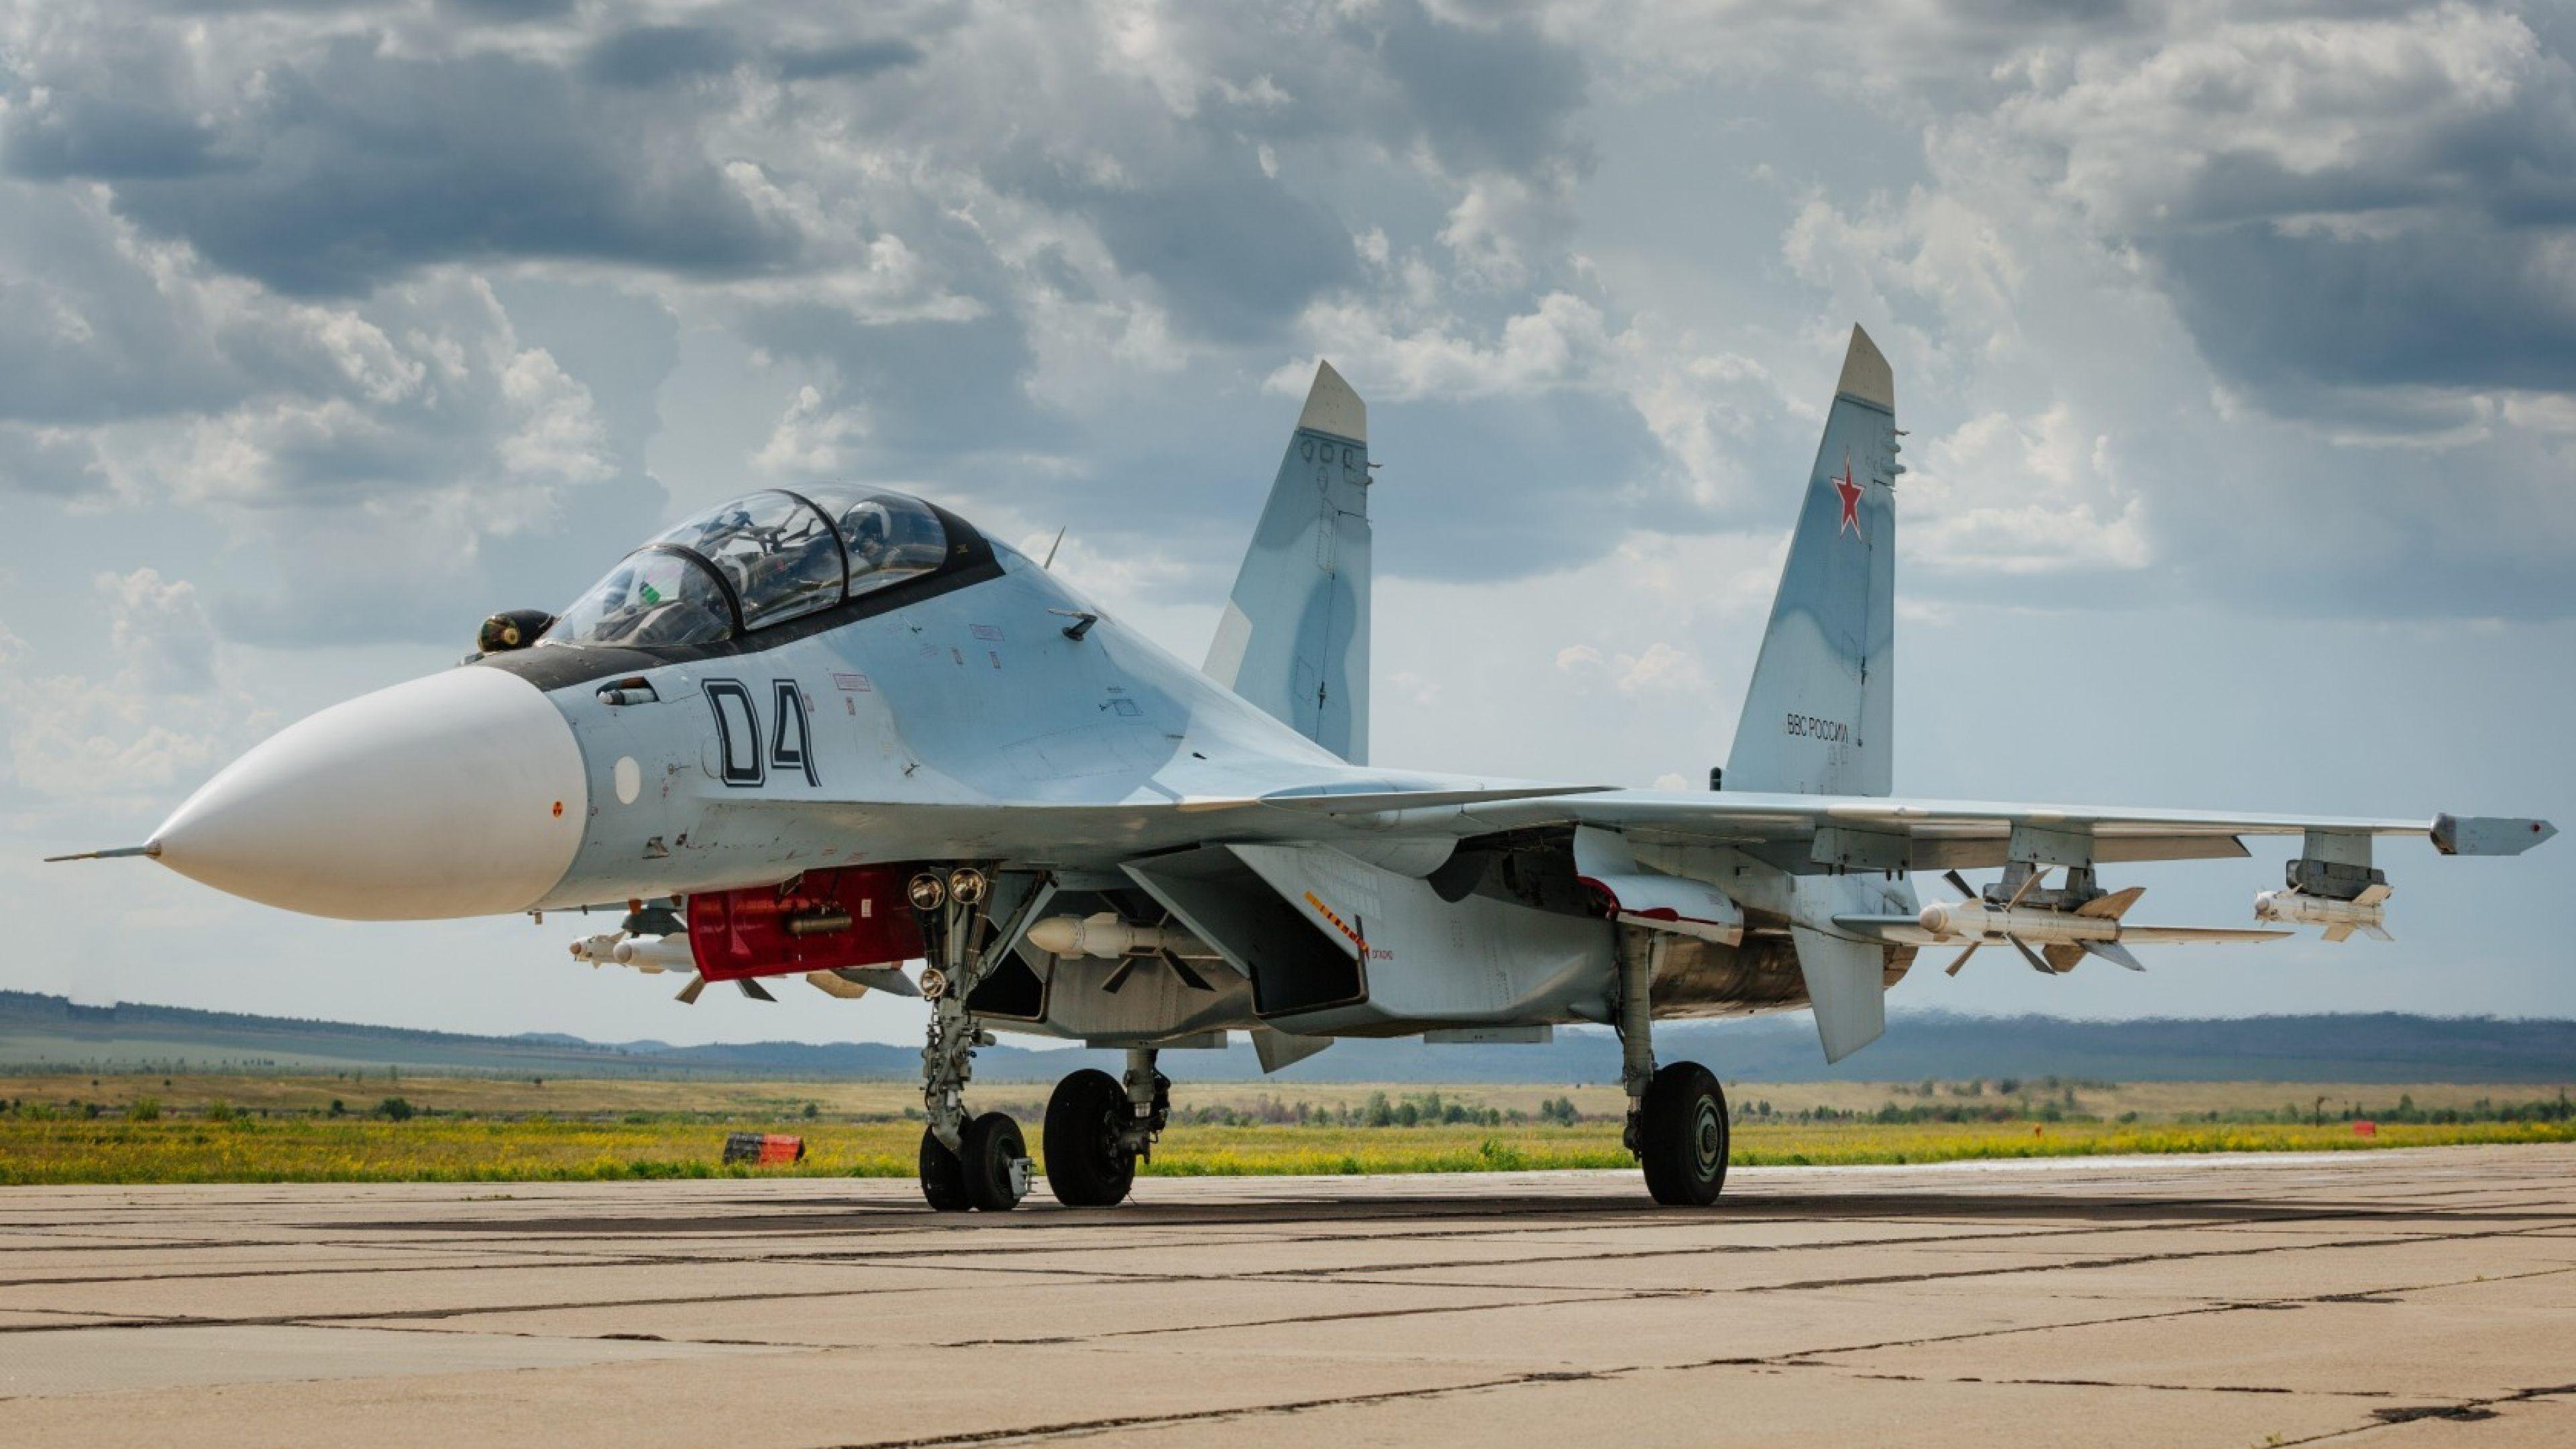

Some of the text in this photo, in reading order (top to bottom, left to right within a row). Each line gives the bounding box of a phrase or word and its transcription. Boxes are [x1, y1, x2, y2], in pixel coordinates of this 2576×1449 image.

[701, 678, 822, 788] 04
[1787, 713, 1848, 744] ВВС РОССИИ
